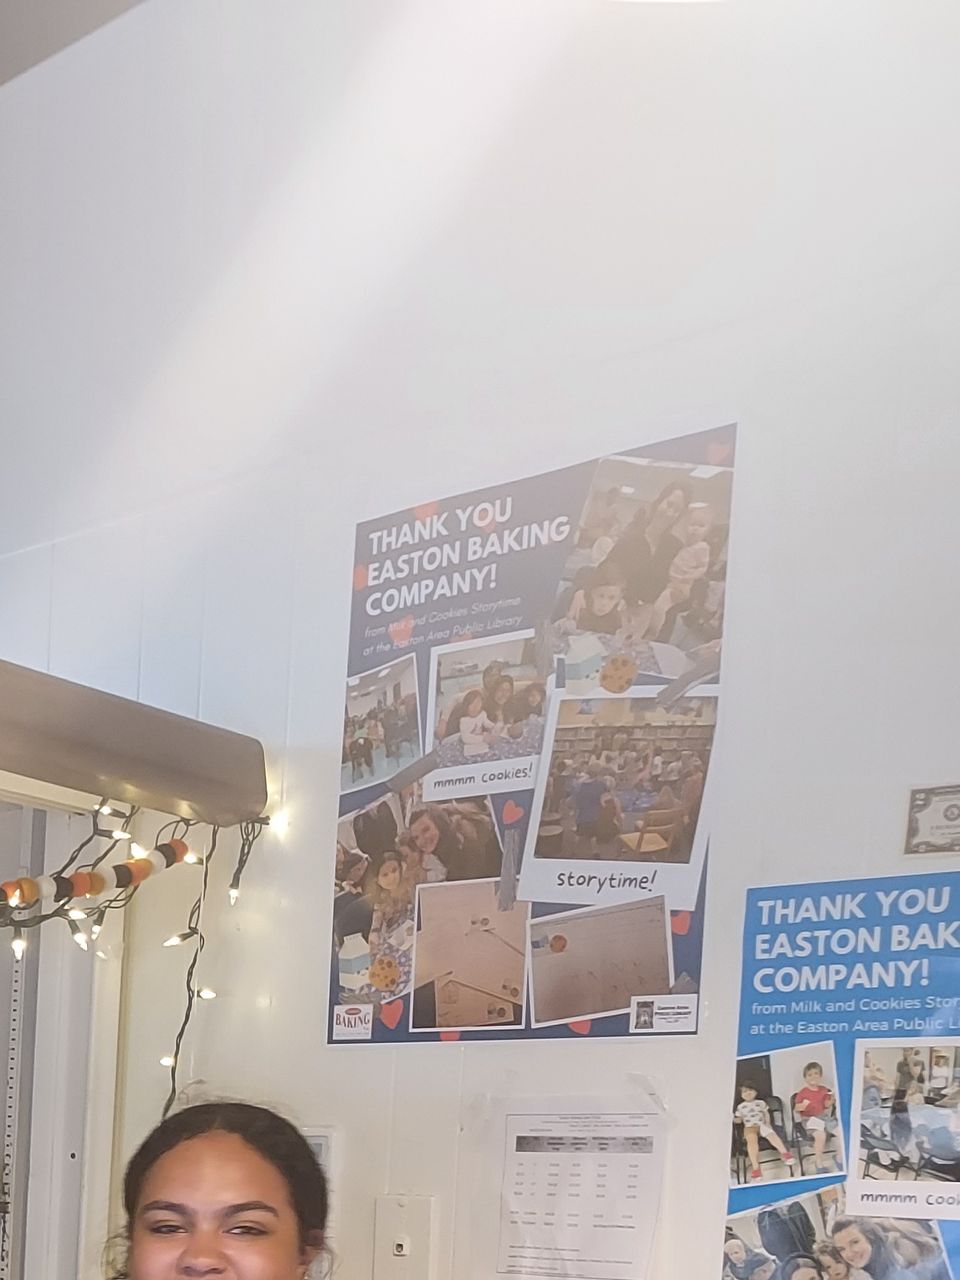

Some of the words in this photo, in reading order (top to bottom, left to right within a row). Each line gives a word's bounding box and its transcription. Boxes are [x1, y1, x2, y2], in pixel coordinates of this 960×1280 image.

[368, 511, 449, 555] THANK
[456, 496, 512, 531] YOU
[367, 540, 460, 587] EASTON
[467, 516, 570, 561] BAKING
[365, 563, 497, 616] COMPANY!
[487, 615, 524, 631] Library
[433, 775, 476, 789] mmmm
[481, 761, 533, 784] cookies!
[557, 869, 658, 894] storytime!
[757, 892, 868, 926] THANK
[875, 886, 951, 917] YOU
[754, 925, 882, 960] EASTON
[890, 920, 960, 952] BAK
[752, 958, 930, 994] COMPANY!
[751, 1002, 787, 1015] from
[790, 1000, 822, 1014] Milk
[825, 999, 856, 1012] and
[859, 997, 921, 1011] Cookies
[925, 995, 960, 1010] Stor
[750, 1024, 766, 1035] at
[769, 1021, 794, 1034] the
[797, 1020, 849, 1034] Easton
[852, 1019, 889, 1032] Area
[893, 1017, 944, 1031] Public
[860, 1193, 918, 1204] mmmm
